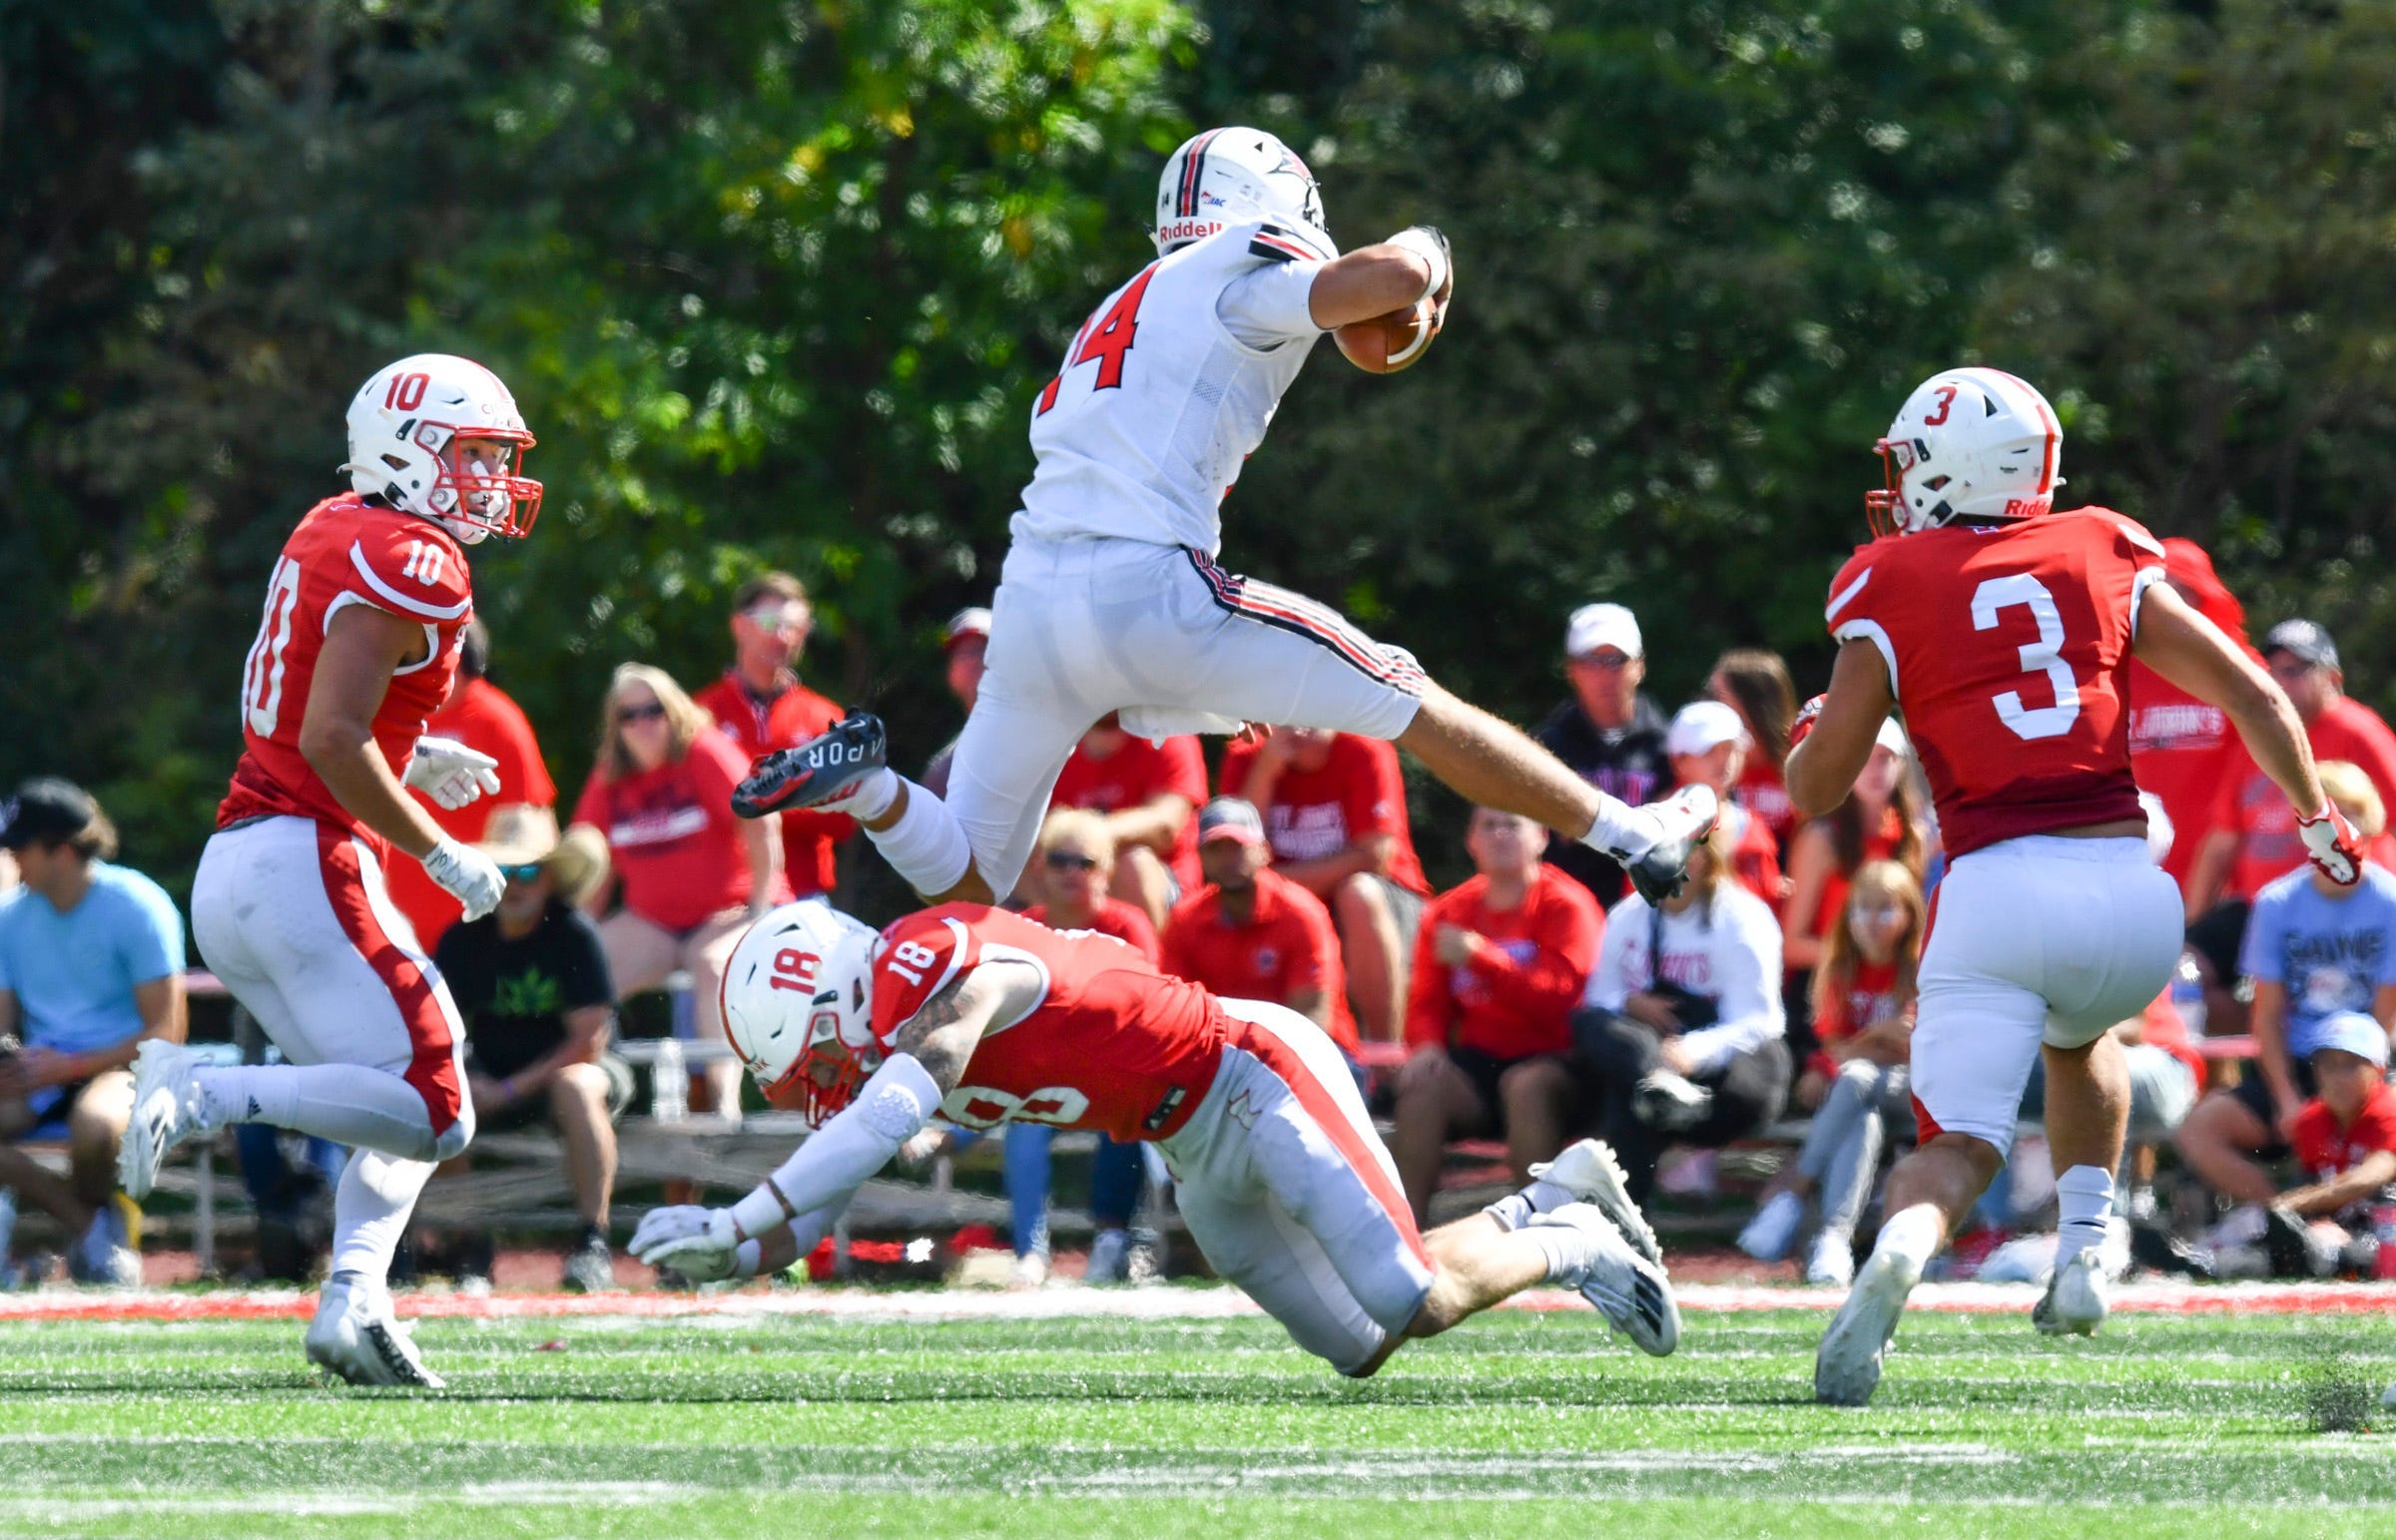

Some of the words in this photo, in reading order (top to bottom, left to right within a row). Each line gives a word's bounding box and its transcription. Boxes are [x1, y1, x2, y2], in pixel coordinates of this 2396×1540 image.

[384, 372, 430, 411] 10
[1925, 386, 1958, 425] 3
[402, 540, 444, 587] 10
[1970, 573, 2081, 741] 3
[770, 948, 822, 995] 18
[888, 940, 936, 987] 18
